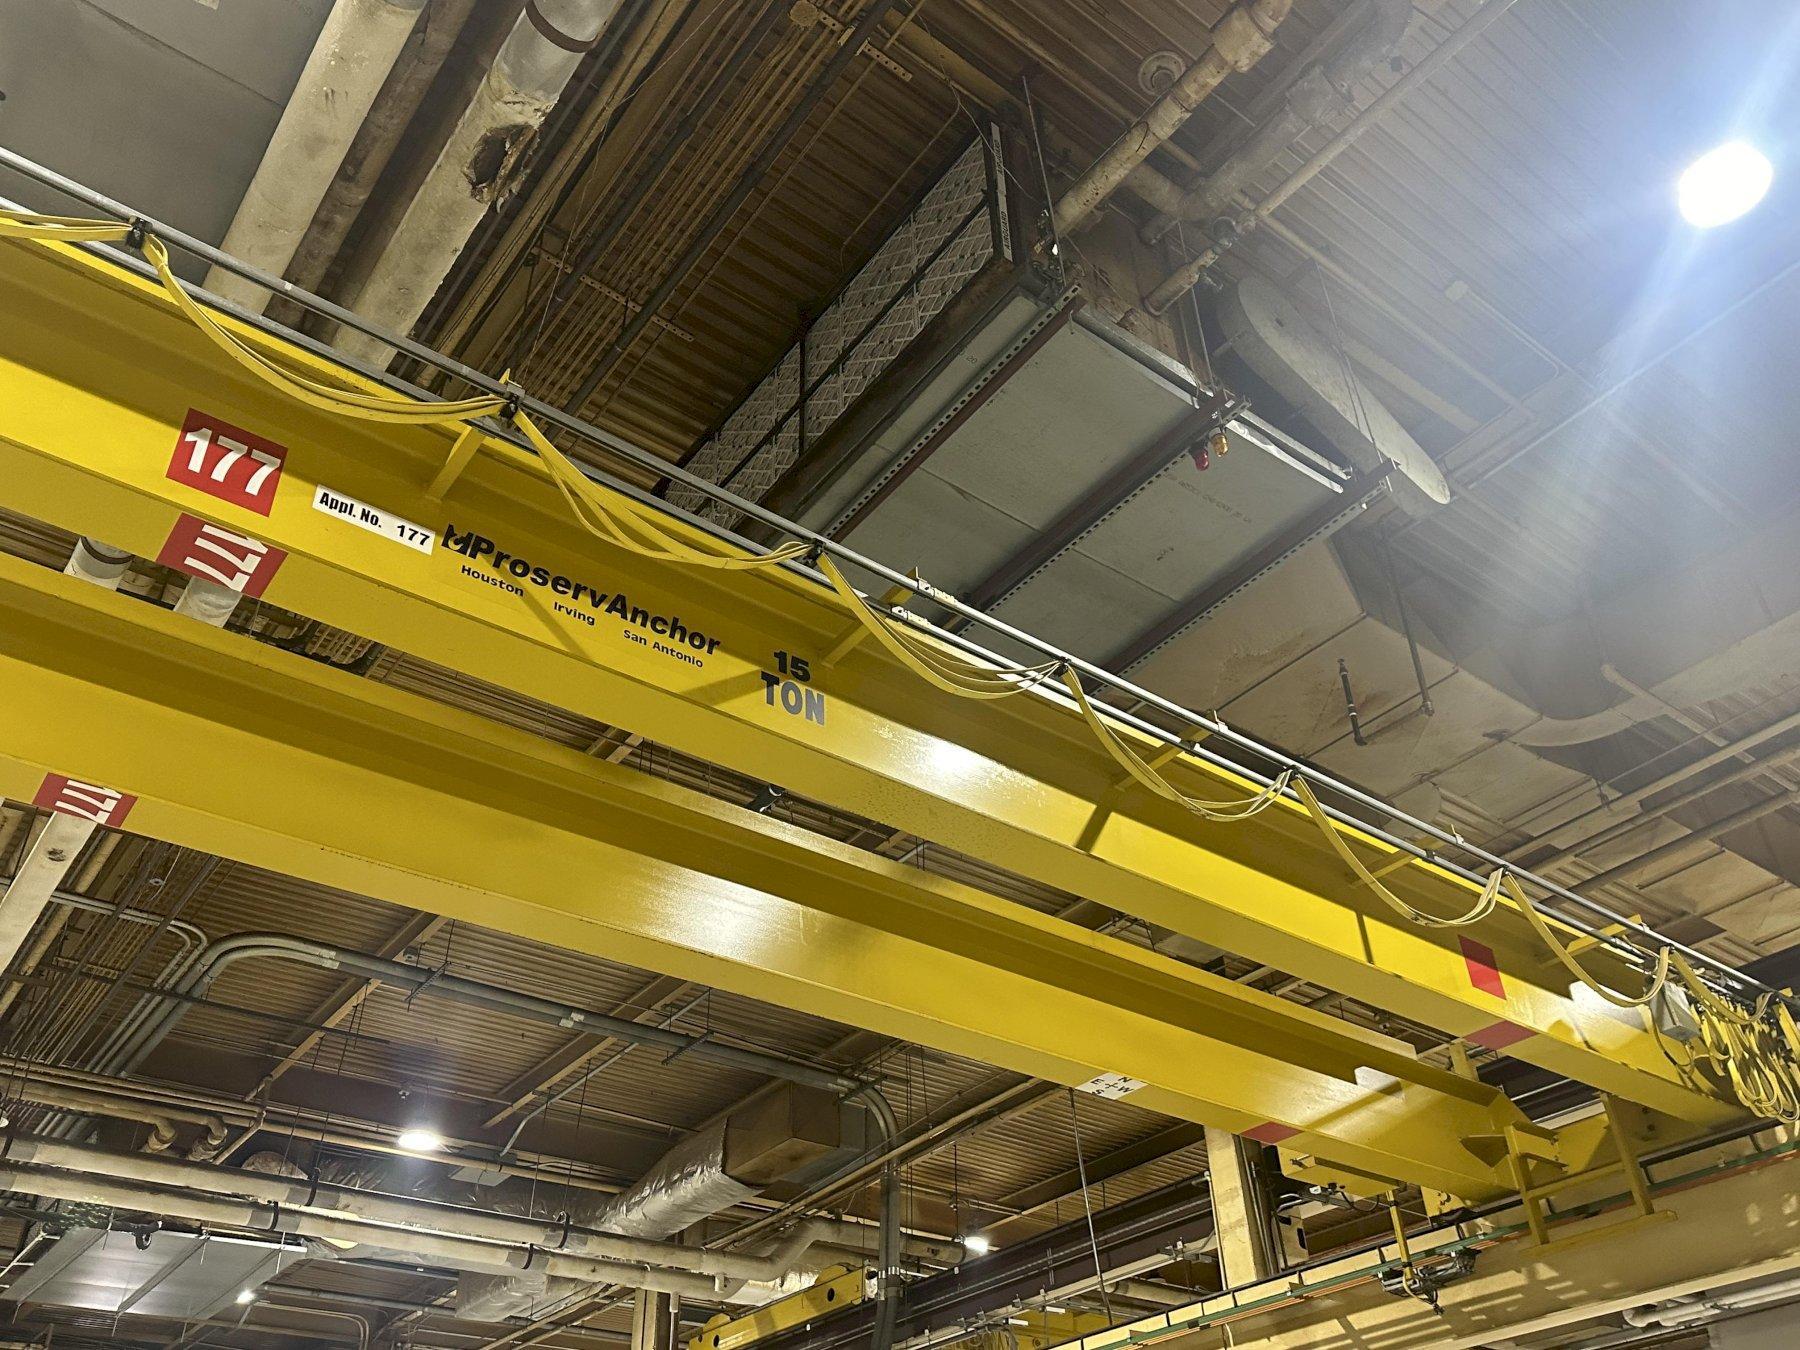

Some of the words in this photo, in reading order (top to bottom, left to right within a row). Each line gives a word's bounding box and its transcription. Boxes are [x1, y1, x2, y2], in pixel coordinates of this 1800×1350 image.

[184, 427, 282, 496] 177
[319, 492, 356, 517] Appl.
[360, 507, 382, 528] No.
[396, 524, 431, 546] 177
[184, 524, 269, 592] 177
[461, 564, 524, 598] Houston
[553, 601, 596, 627] Irving
[623, 628, 647, 646] San
[652, 641, 704, 668] Antonio
[467, 533, 721, 656] ProservAnchor
[773, 650, 811, 683] 15
[760, 670, 825, 726] TON
[54, 779, 123, 824] 177
